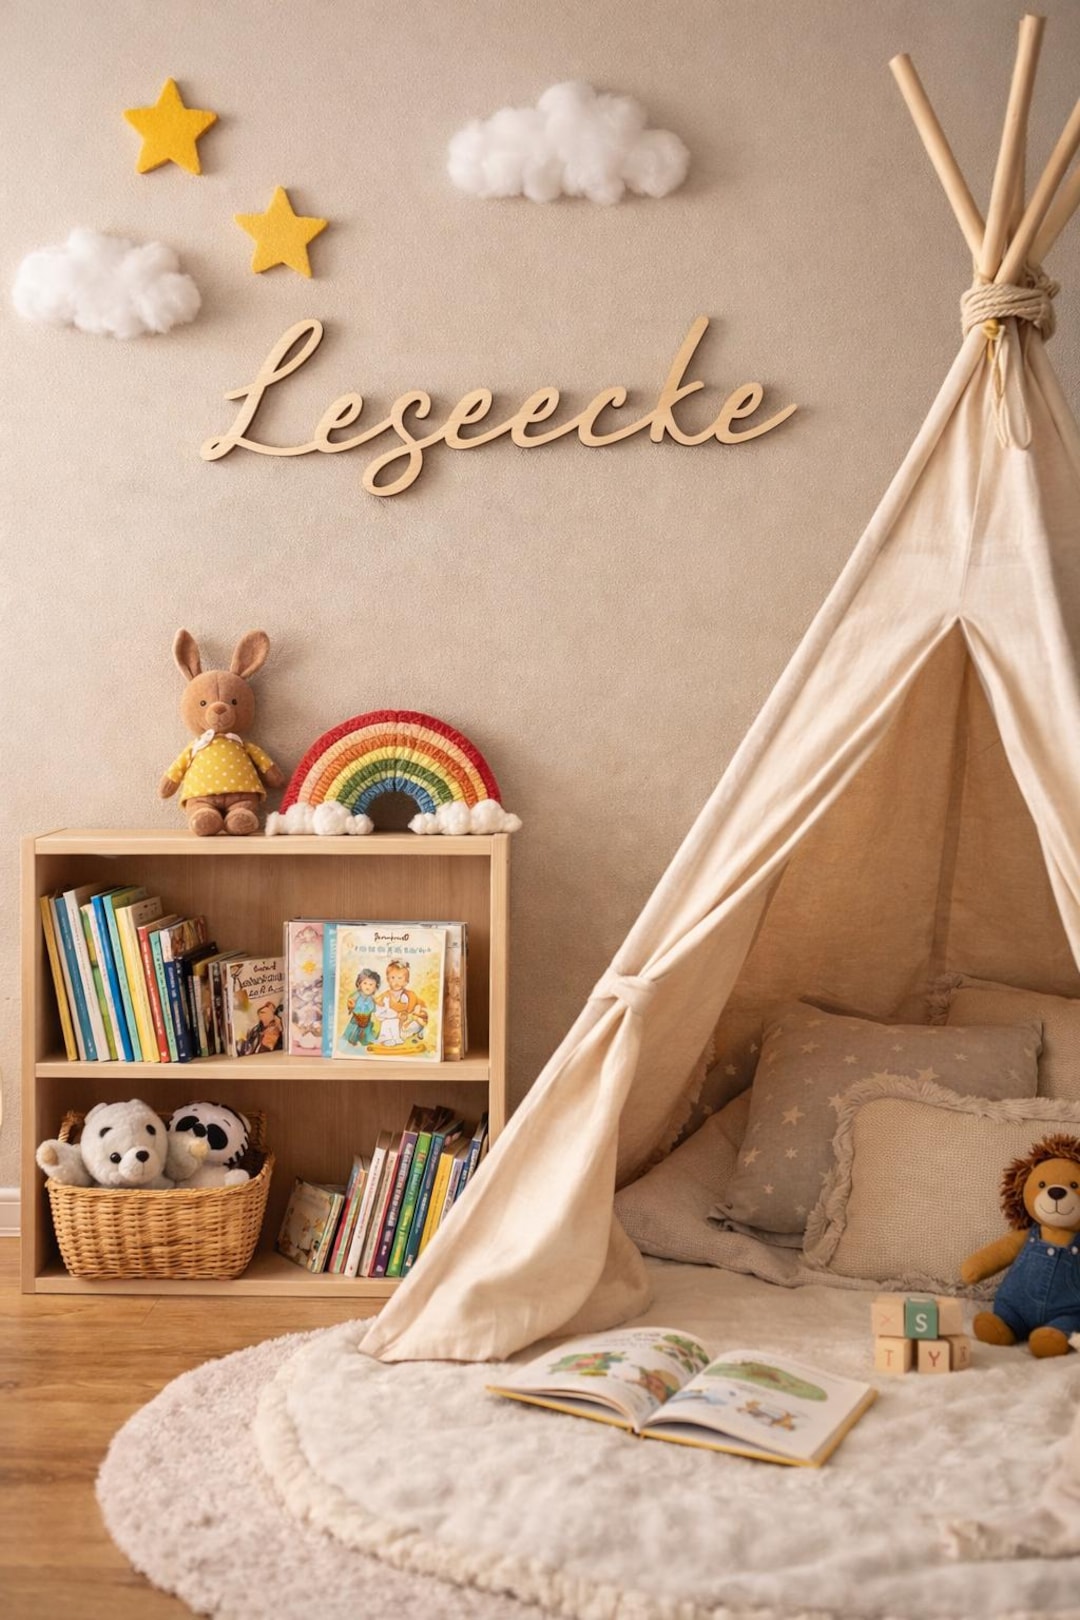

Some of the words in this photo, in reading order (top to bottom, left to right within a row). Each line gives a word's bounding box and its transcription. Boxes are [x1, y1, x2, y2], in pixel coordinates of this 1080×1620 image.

[200, 316, 798, 498] Leseecke
[915, 1313, 928, 1332] S
[884, 1349, 894, 1367] T
[928, 1351, 941, 1367] Y
